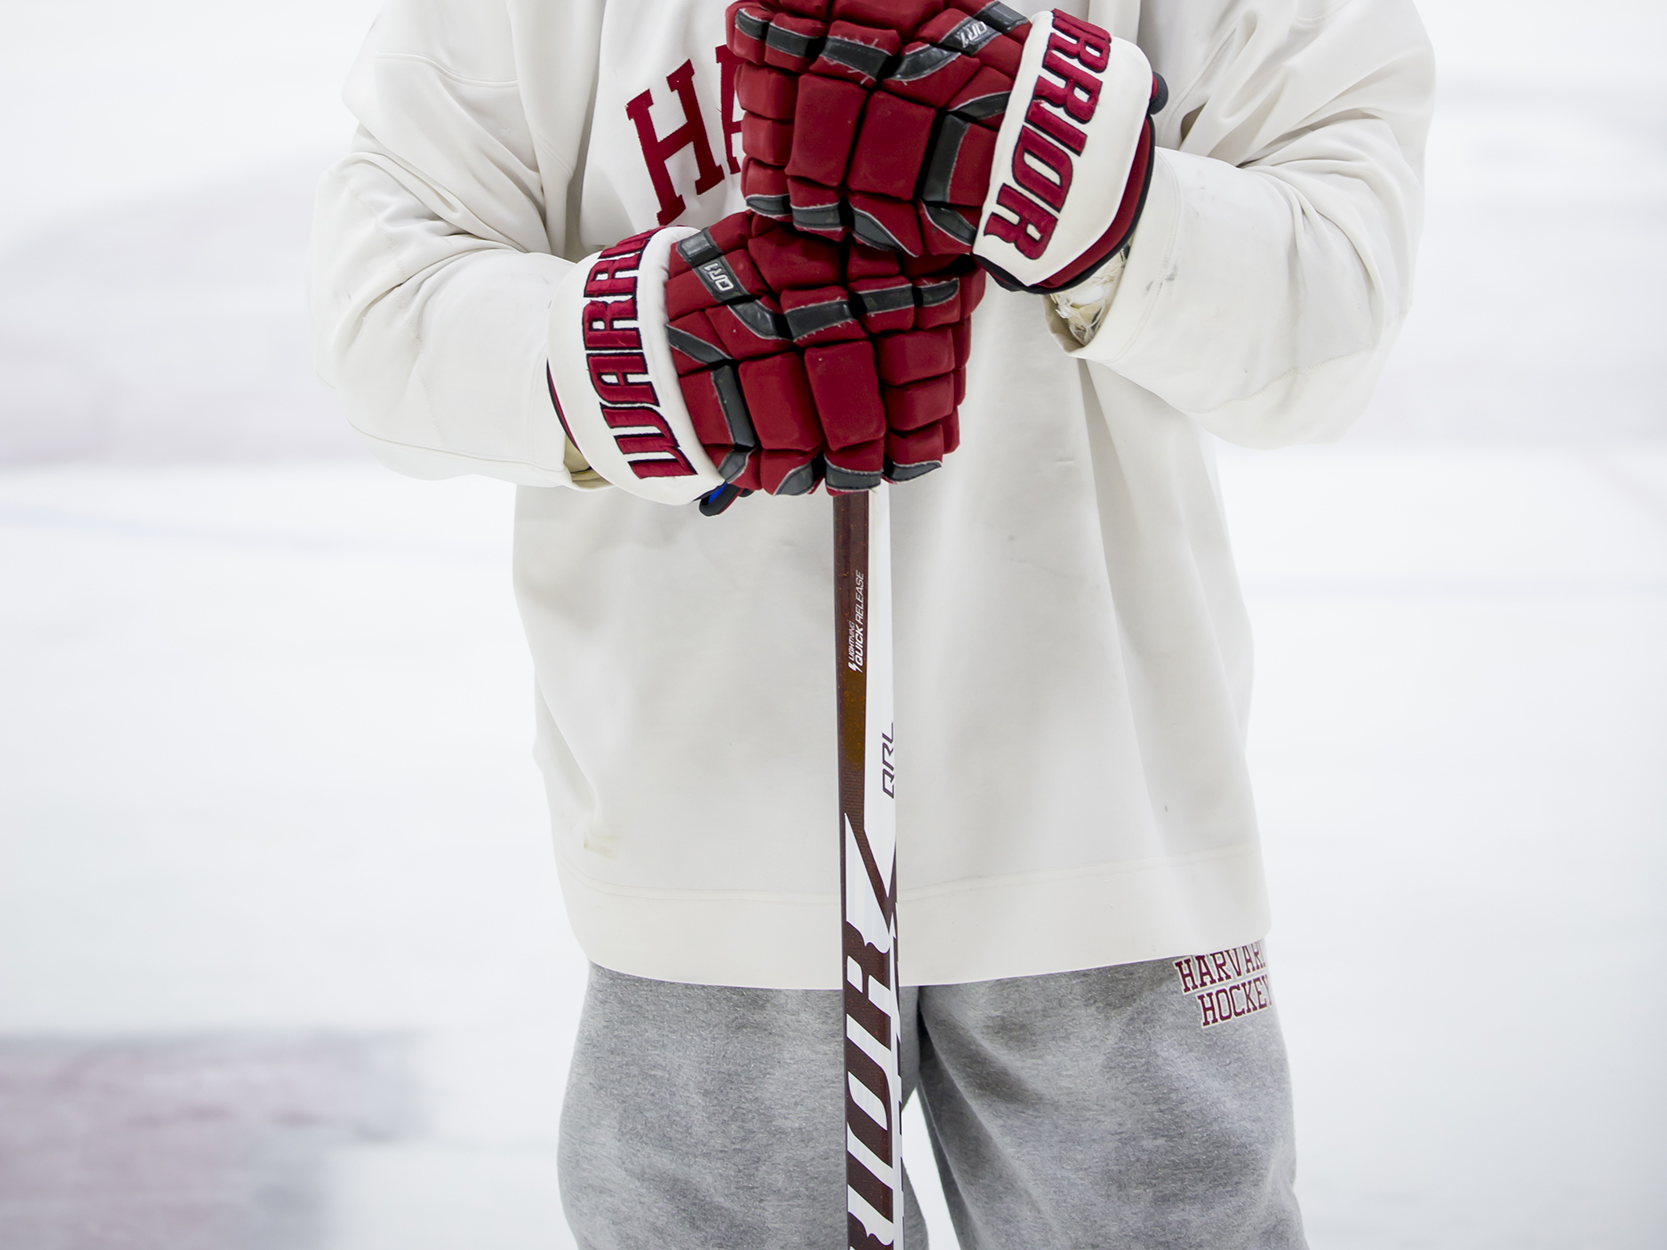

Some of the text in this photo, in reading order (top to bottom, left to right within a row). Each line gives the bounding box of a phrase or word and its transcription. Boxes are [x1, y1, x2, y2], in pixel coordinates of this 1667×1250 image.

[704, 262, 735, 292] QR1
[855, 569, 864, 667] QUICK RELEASE
[848, 620, 856, 662] LIGHTNING
